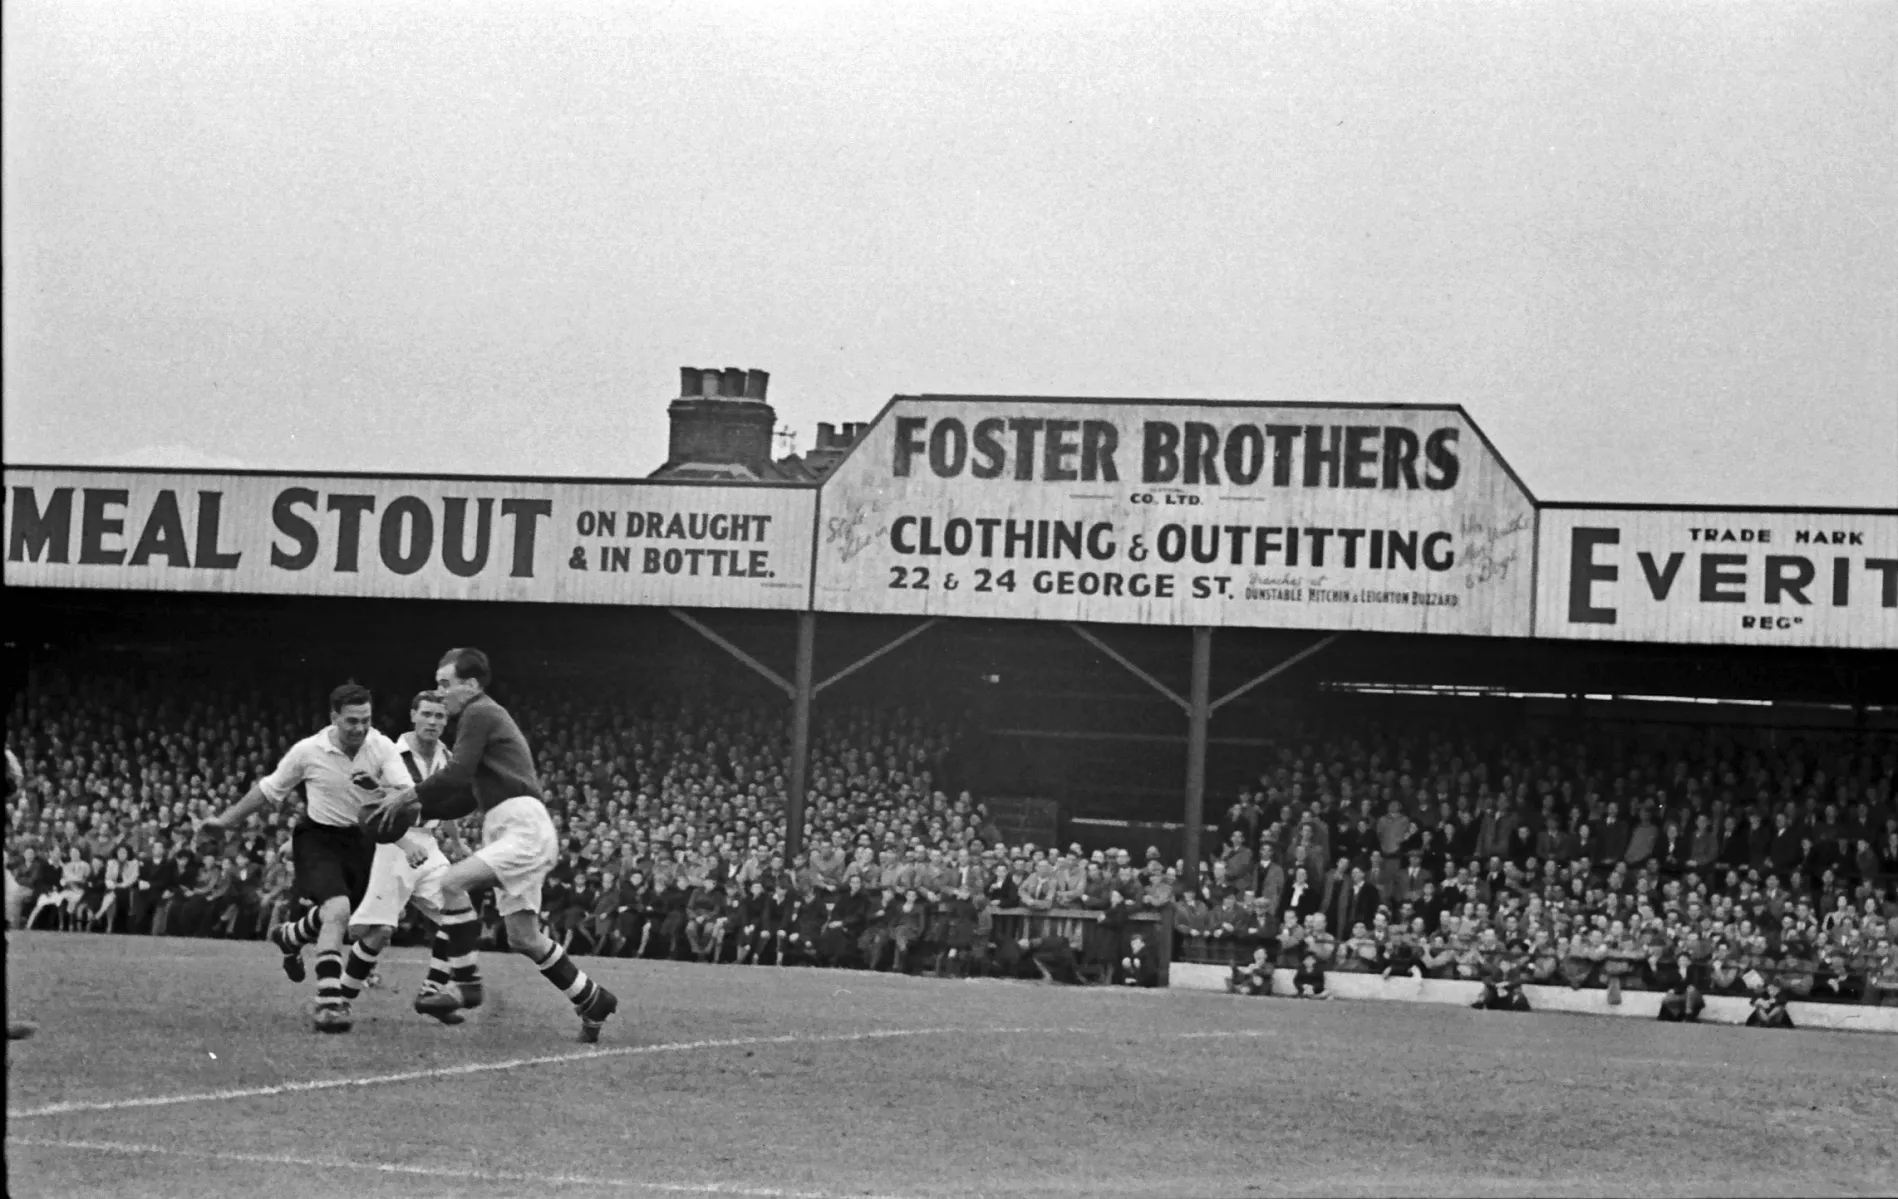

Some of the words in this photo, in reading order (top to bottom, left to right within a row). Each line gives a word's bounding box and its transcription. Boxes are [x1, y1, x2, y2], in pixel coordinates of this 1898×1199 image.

[893, 416, 1120, 482] FOSTER
[1142, 420, 1460, 492] BROTHERS
[1165, 493, 1205, 506] LTD.
[7, 486, 243, 570] MEAL
[271, 486, 553, 578] STOUT
[576, 510, 617, 538] ON
[626, 512, 772, 543] DRAUGHT
[1688, 528, 1772, 543] TRADE
[1795, 529, 1865, 546] MARK
[890, 515, 1117, 561] CLOTHING
[1128, 533, 1150, 562] &
[1156, 522, 1456, 572] OUTFITTING
[568, 546, 589, 571] &
[600, 546, 631, 574] IN
[642, 547, 776, 579] BOTTLE.
[888, 566, 931, 590] 22
[943, 572, 960, 591] &
[973, 568, 1017, 593] 24
[1033, 570, 1175, 599] GEORGE
[1191, 575, 1235, 600] ST.
